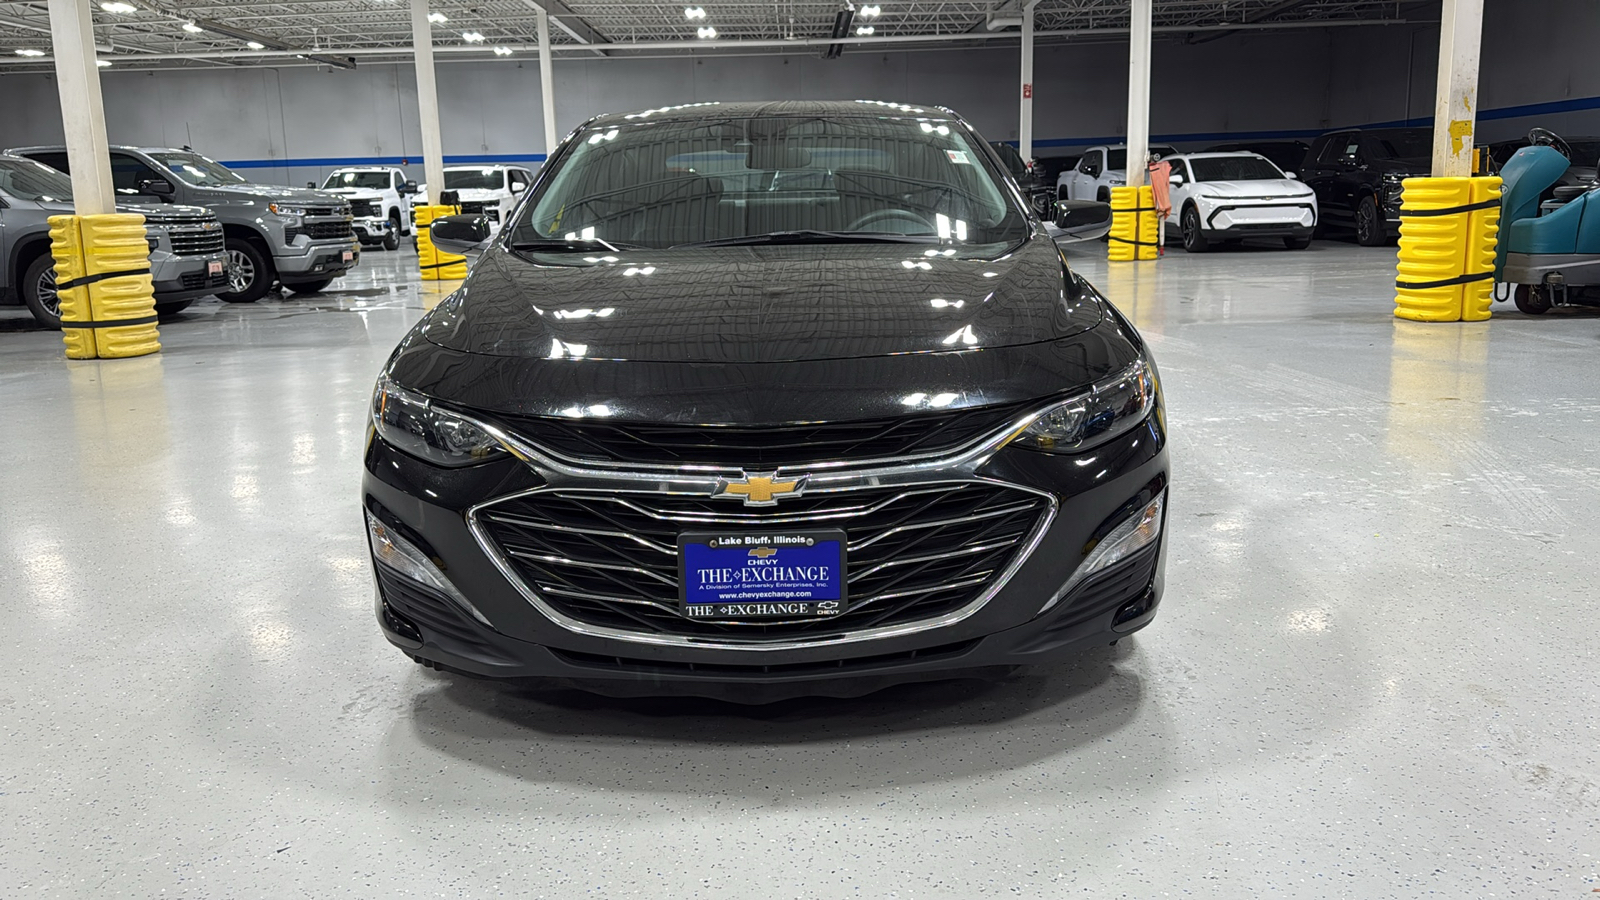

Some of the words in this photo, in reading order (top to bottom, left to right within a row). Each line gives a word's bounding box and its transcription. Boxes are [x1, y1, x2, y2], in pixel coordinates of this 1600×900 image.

[718, 537, 742, 545] Lake
[744, 536, 771, 545] Bluff,
[773, 535, 806, 544] Illinois
[697, 568, 733, 584] THE
[741, 566, 830, 582] EXCHANGE
[718, 590, 812, 600] www.chevyexchange.com
[685, 605, 714, 616] THE
[727, 603, 809, 616] EXCHANGE
